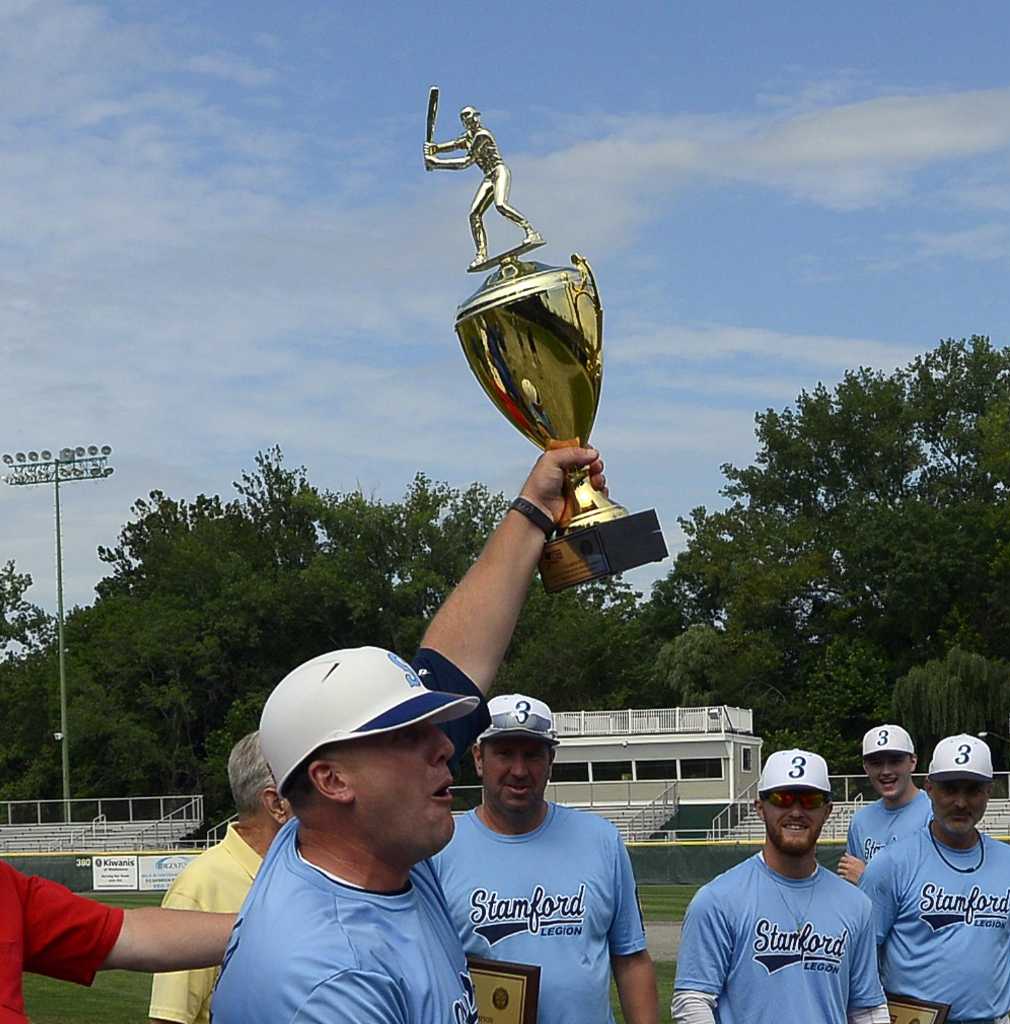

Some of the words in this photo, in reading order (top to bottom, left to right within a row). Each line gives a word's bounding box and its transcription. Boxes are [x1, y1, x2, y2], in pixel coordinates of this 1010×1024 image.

[515, 700, 532, 725] 3
[877, 729, 889, 746] 3
[954, 743, 972, 766] 3
[788, 755, 807, 779] 3
[103, 858, 135, 867] Kiwanis
[470, 884, 586, 933] Stamford
[920, 882, 1010, 925] Stamford
[540, 926, 583, 937] LEGION
[974, 919, 1006, 929] LEGION
[753, 918, 847, 960] Stamford
[803, 962, 840, 974] LEGON
